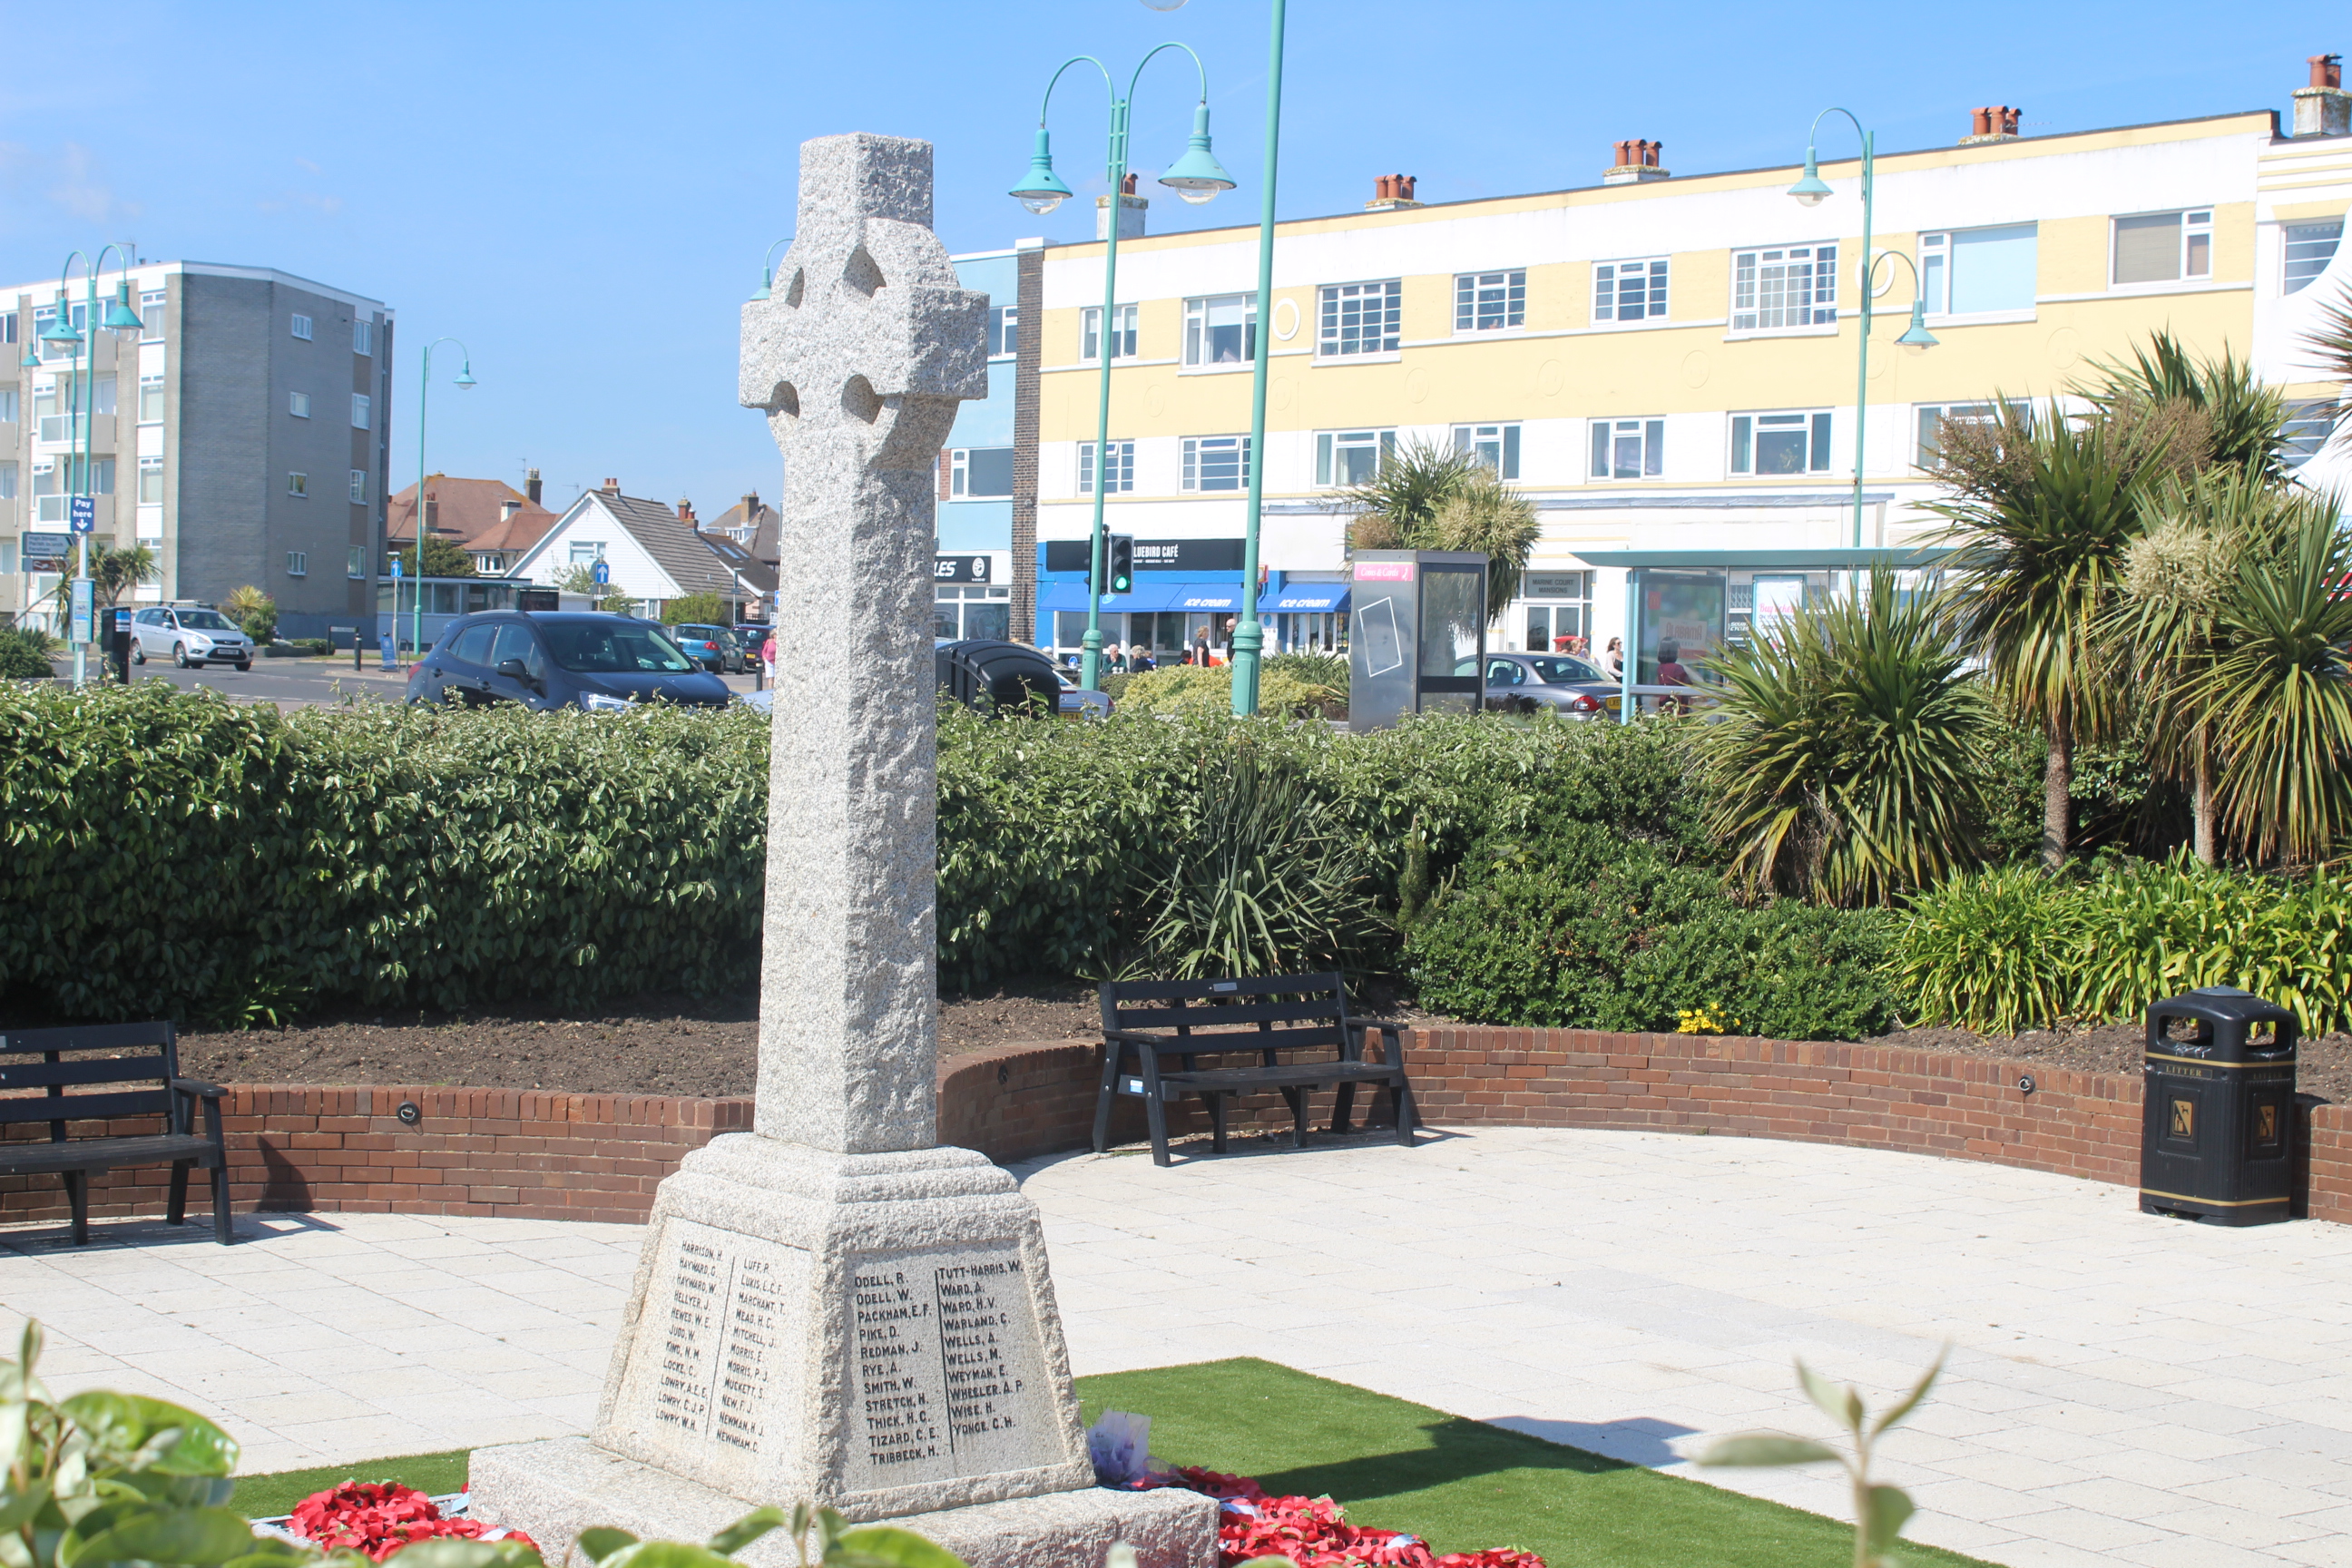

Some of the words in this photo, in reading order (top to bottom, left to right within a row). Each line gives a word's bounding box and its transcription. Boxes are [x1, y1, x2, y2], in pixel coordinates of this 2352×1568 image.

[75, 499, 92, 509] Pay
[73, 509, 93, 518] here
[1133, 545, 1161, 558] LUEBIRD
[1161, 544, 1179, 558] CAFÉ
[1200, 598, 1232, 607] cream
[1296, 598, 1331, 608] cream
[2166, 1065, 2202, 1077] LITTER
[1007, 1259, 1024, 1272] W.
[855, 1275, 894, 1288] ODELL,
[896, 1272, 909, 1285] R.
[974, 1281, 985, 1293] A.
[857, 1292, 897, 1305] ODELL,
[897, 1289, 913, 1301] W.
[889, 1326, 900, 1338] D.
[988, 1332, 999, 1344] A.
[861, 1344, 909, 1359] REDMAN,
[912, 1341, 923, 1353] J.
[989, 1348, 1002, 1360] M.
[890, 1361, 902, 1375] A.
[864, 1380, 900, 1395] SMITH,
[902, 1377, 917, 1389] W.
[917, 1393, 929, 1406] H.
[928, 1445, 939, 1457] H.
